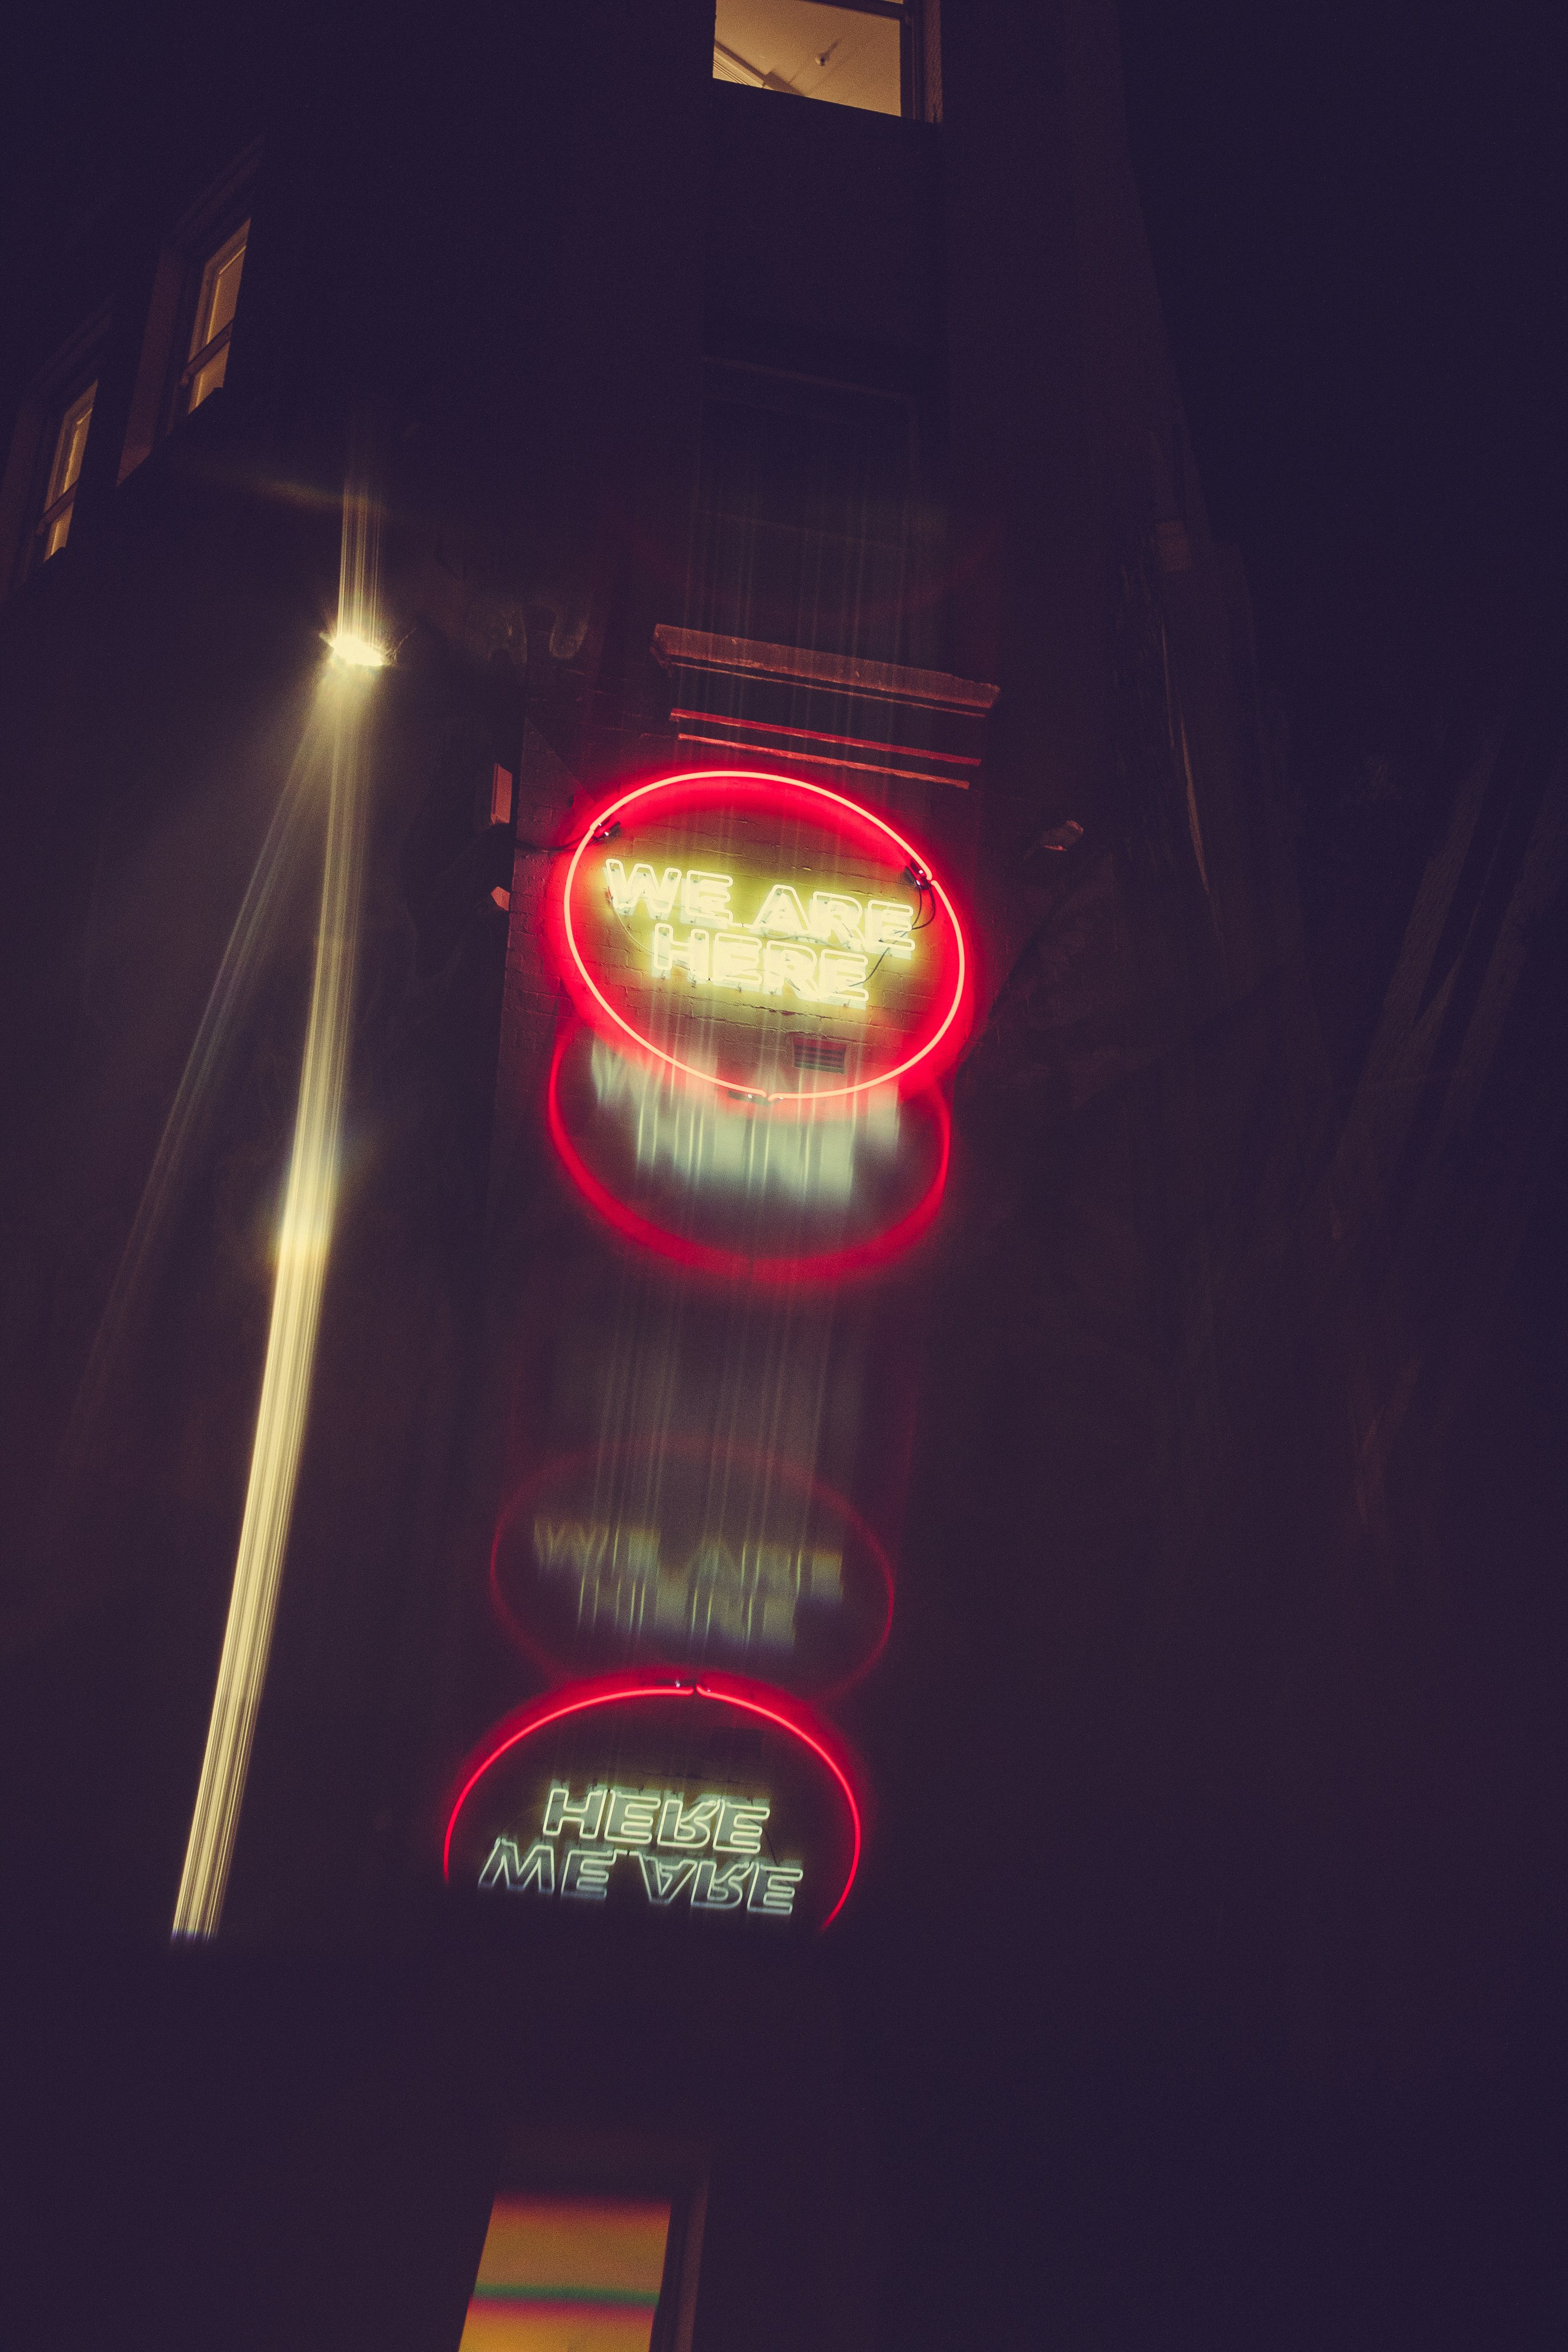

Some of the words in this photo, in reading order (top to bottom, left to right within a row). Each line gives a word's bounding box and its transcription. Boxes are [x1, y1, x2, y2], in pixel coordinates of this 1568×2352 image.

[606, 858, 733, 926] WE
[755, 884, 915, 951] ARE
[654, 923, 868, 1001] HERE
